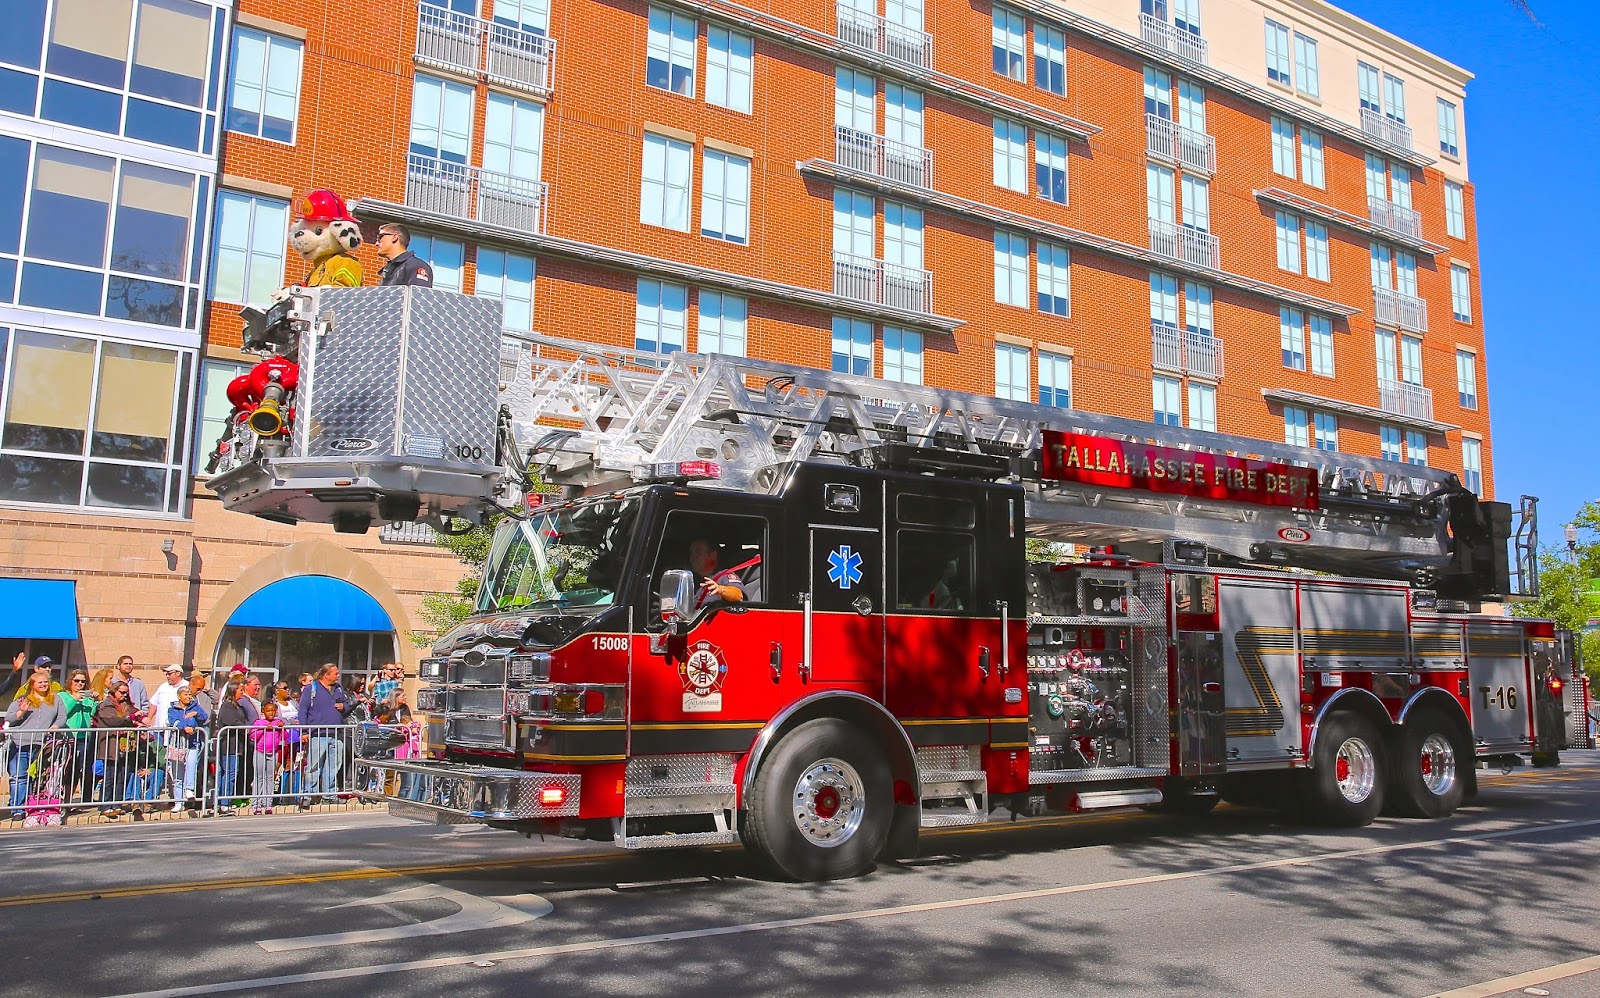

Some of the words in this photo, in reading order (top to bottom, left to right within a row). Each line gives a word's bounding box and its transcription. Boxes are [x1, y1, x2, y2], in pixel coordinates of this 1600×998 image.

[335, 438, 367, 449] Pierce
[1053, 443, 1205, 486] TALLAHASSEE
[1214, 465, 1258, 492] FIRE
[1265, 472, 1315, 498] DEPT.
[592, 636, 628, 651] 15008
[694, 687, 710, 695] DEPT
[1479, 685, 1517, 710] T-16
